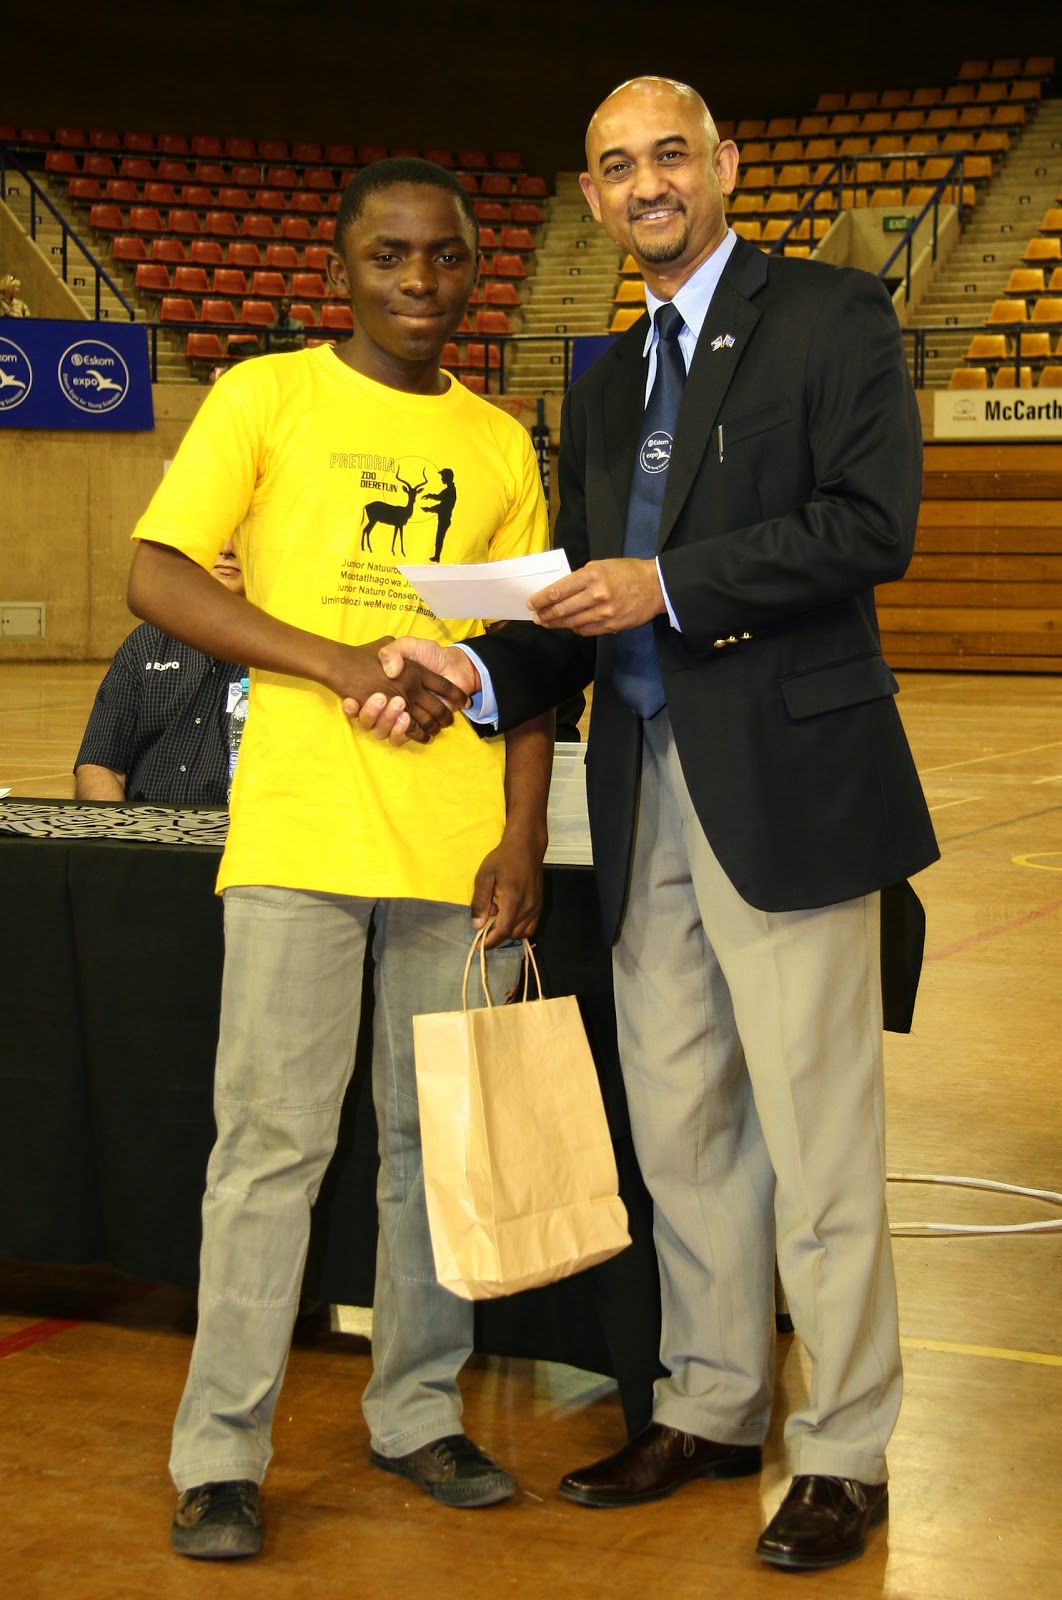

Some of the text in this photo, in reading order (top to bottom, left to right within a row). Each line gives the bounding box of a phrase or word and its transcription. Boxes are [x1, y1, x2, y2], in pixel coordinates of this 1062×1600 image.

[83, 355, 115, 366] Eskom
[72, 377, 98, 388] expo
[329, 452, 395, 473] PRETORIA
[361, 470, 377, 481] ZOO
[360, 480, 398, 493] DIERETUIN
[391, 579, 402, 588] wa
[359, 585, 386, 597] Nature
